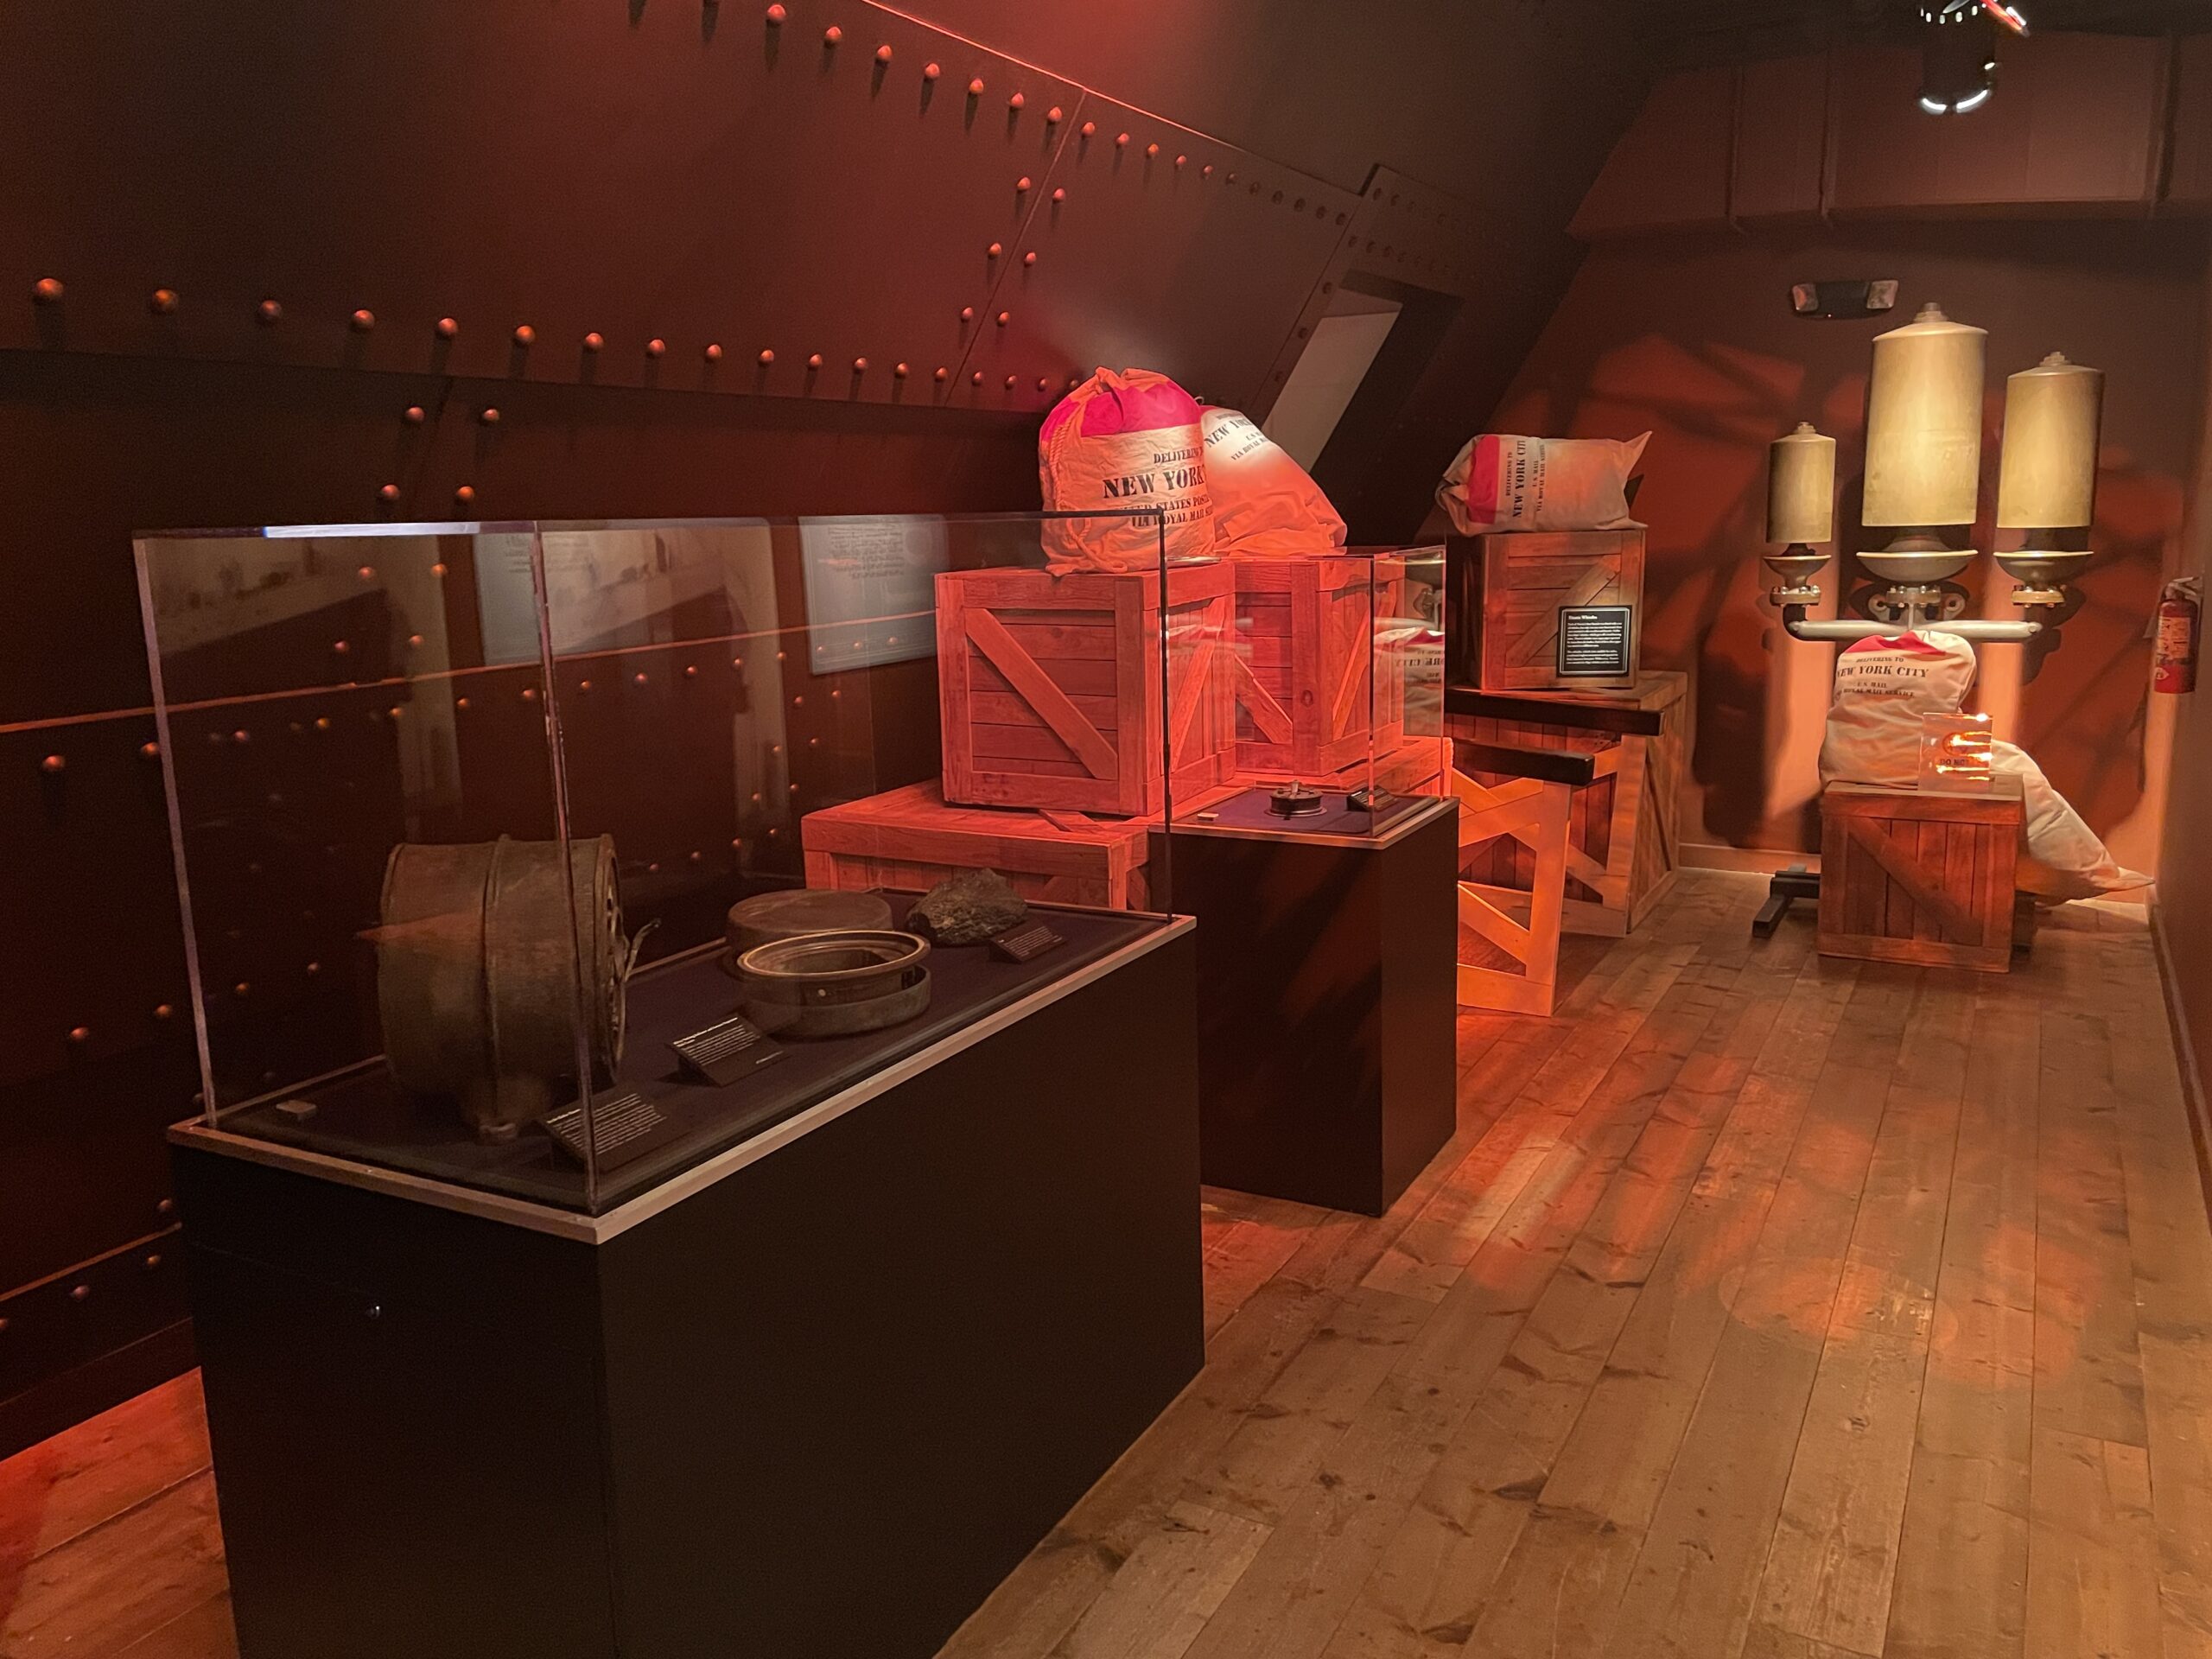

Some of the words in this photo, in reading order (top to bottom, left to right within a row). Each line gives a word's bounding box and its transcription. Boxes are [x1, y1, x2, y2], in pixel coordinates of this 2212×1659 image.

[1204, 424, 1230, 448] NEW
[1103, 473, 1155, 499] NEW
[1162, 463, 1205, 491] YORK
[1515, 459, 1526, 490] YORK
[1512, 493, 1523, 518] NEW
[1859, 665, 1892, 675] YORK
[1897, 666, 1929, 677] CITY
